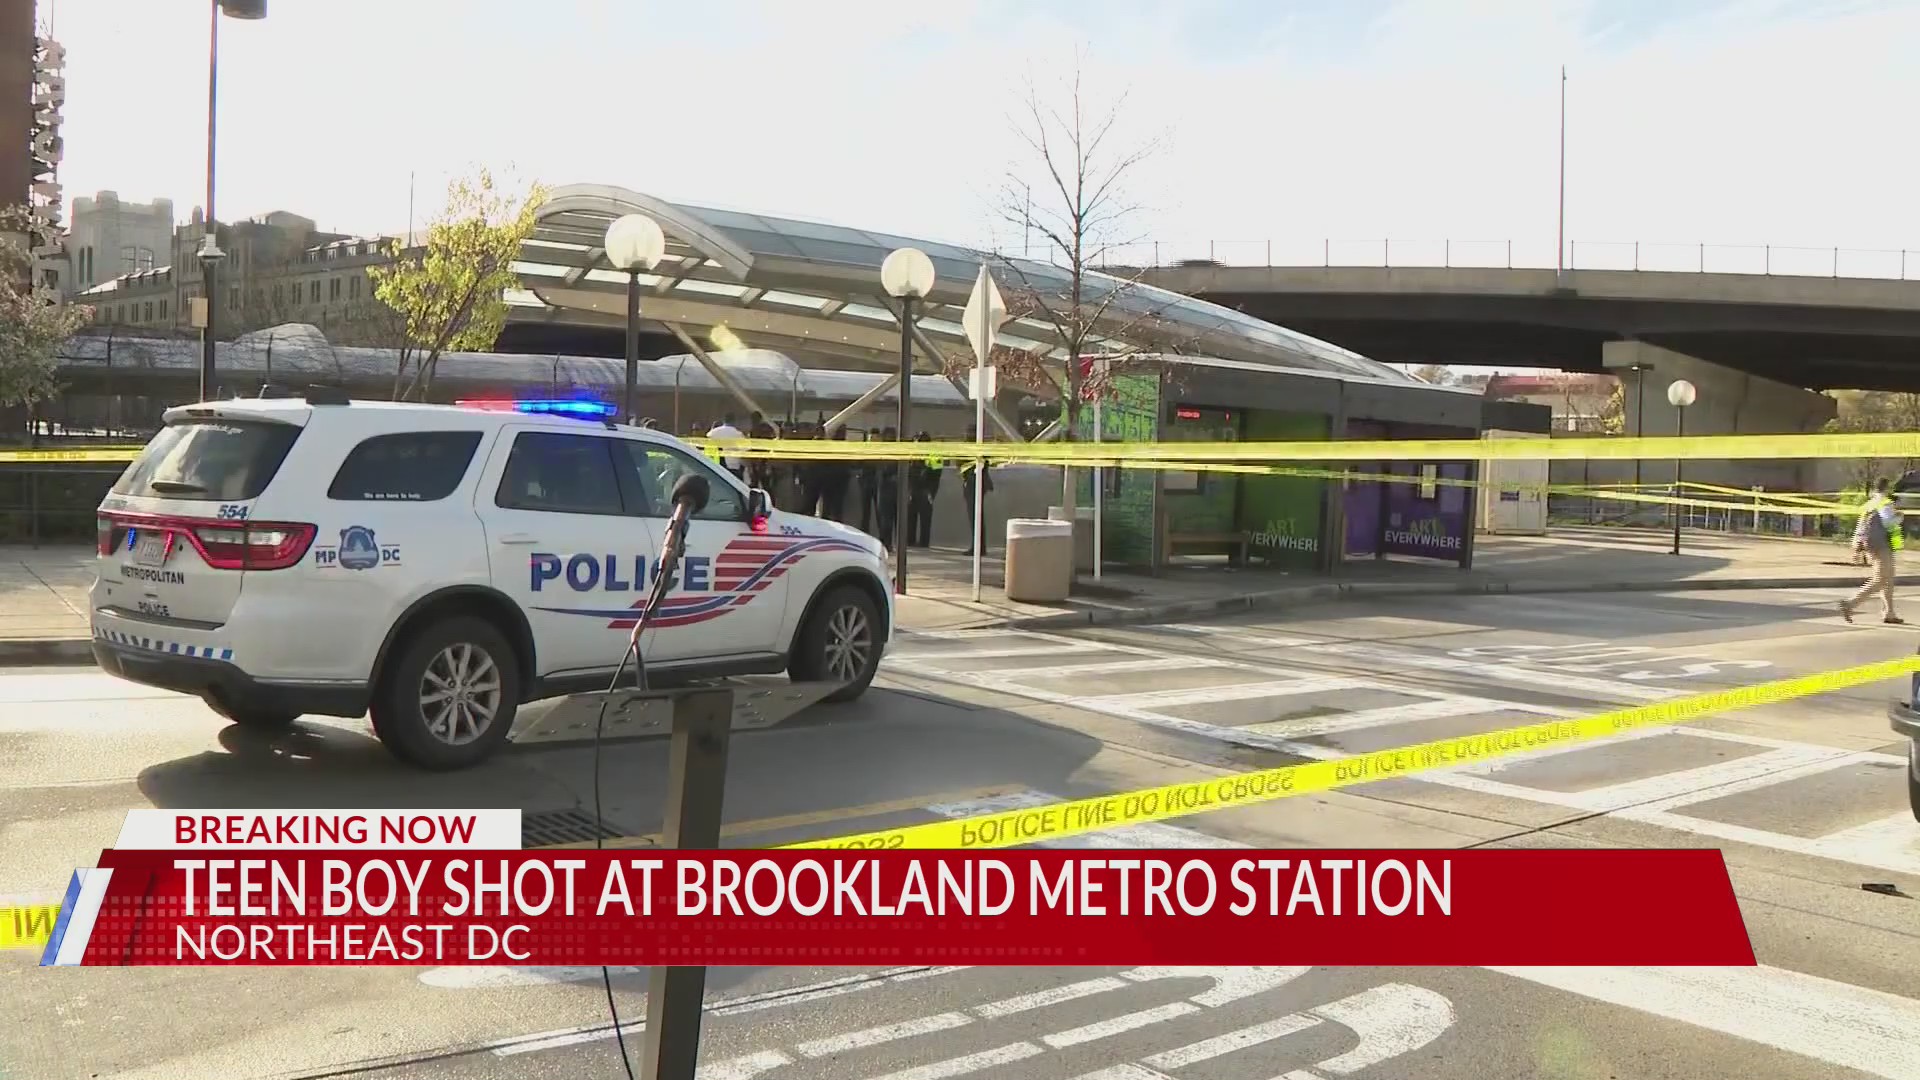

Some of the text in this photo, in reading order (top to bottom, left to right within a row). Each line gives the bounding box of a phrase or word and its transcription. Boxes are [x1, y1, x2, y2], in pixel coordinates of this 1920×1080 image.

[217, 504, 249, 520] 554
[1266, 518, 1297, 536] ART
[1251, 532, 1319, 552] VERYWHERE
[1385, 530, 1462, 549] EVERYWHERE
[315, 549, 400, 564] MP DC
[121, 564, 185, 585] METROPOLITAN
[530, 552, 710, 592] POLICE
[138, 602, 170, 617] POLICE
